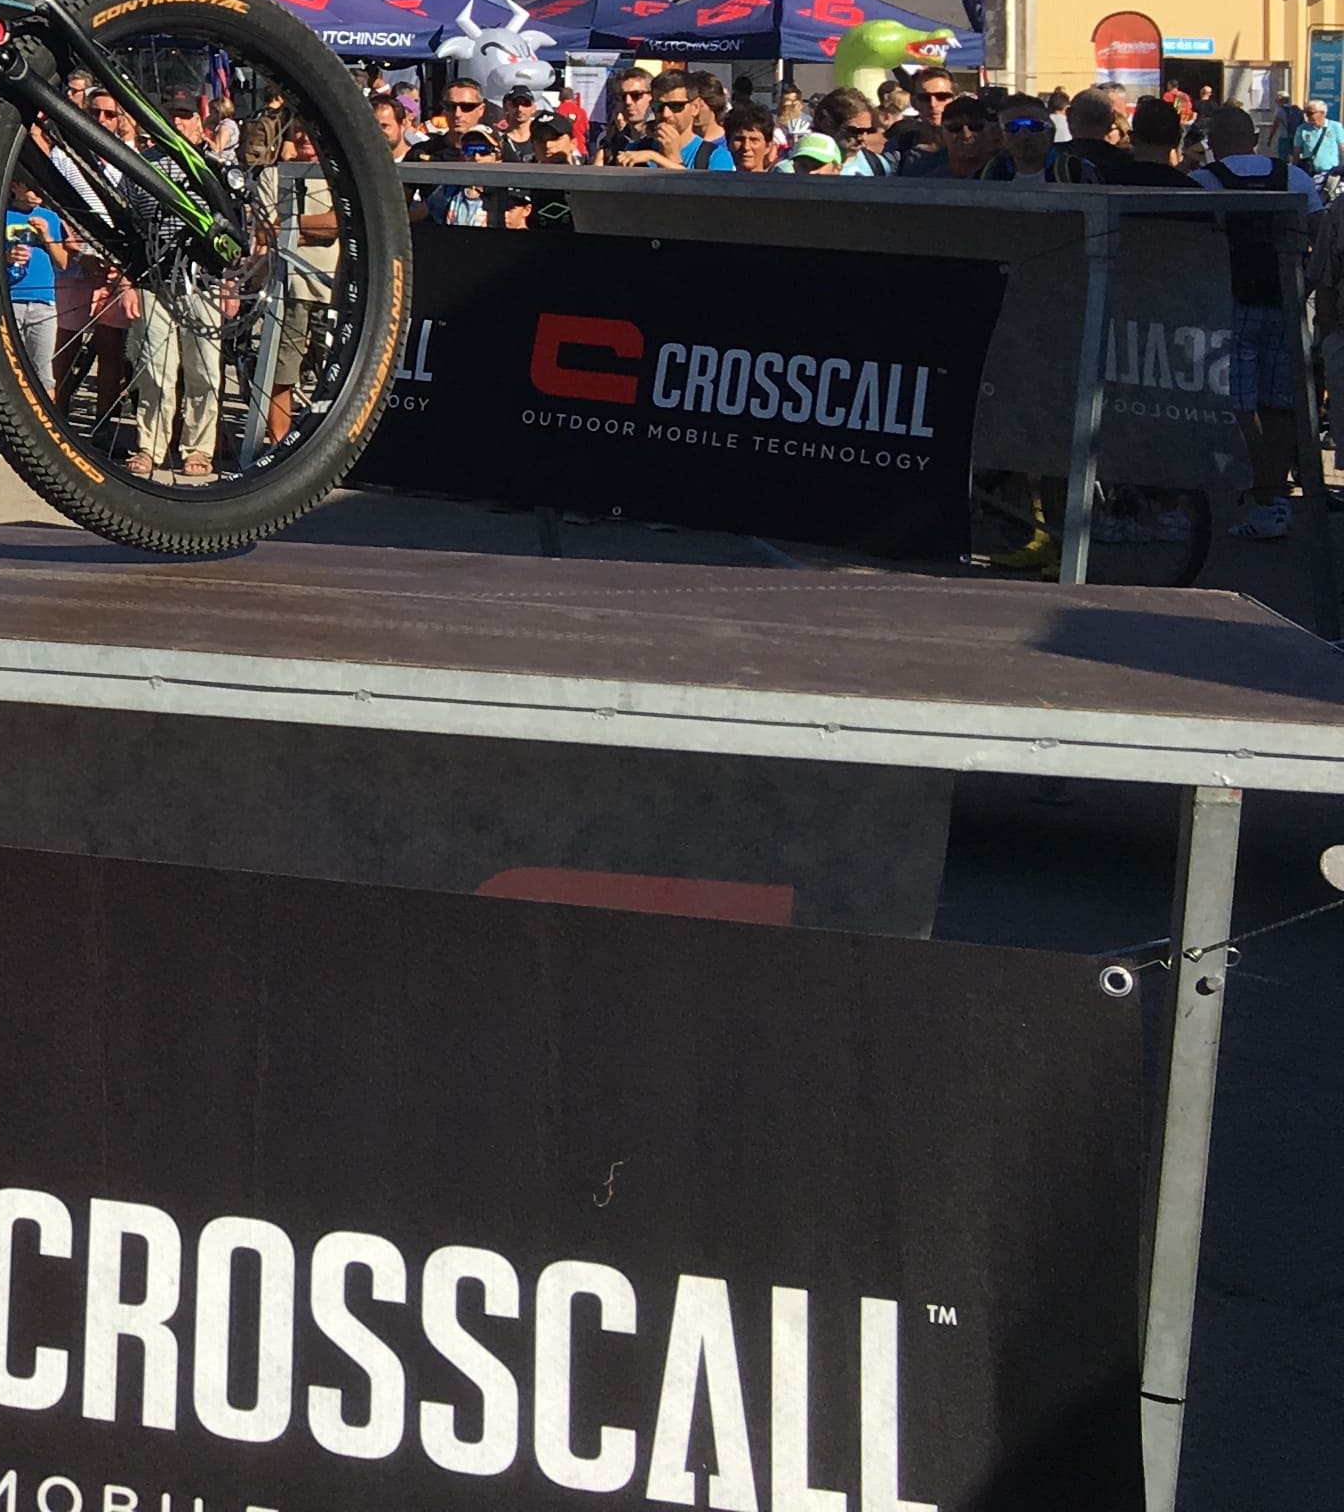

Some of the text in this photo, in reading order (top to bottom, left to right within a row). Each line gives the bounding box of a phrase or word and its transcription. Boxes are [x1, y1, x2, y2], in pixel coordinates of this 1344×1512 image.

[315, 30, 412, 47] UTCHINSON
[347, 256, 404, 444] CONTINENTAL
[652, 343, 934, 438] CROSSCALL
[0, 315, 108, 485] CONTINENTAL
[522, 410, 932, 472] OUTDOOR MOBILE TECHNOLOGY
